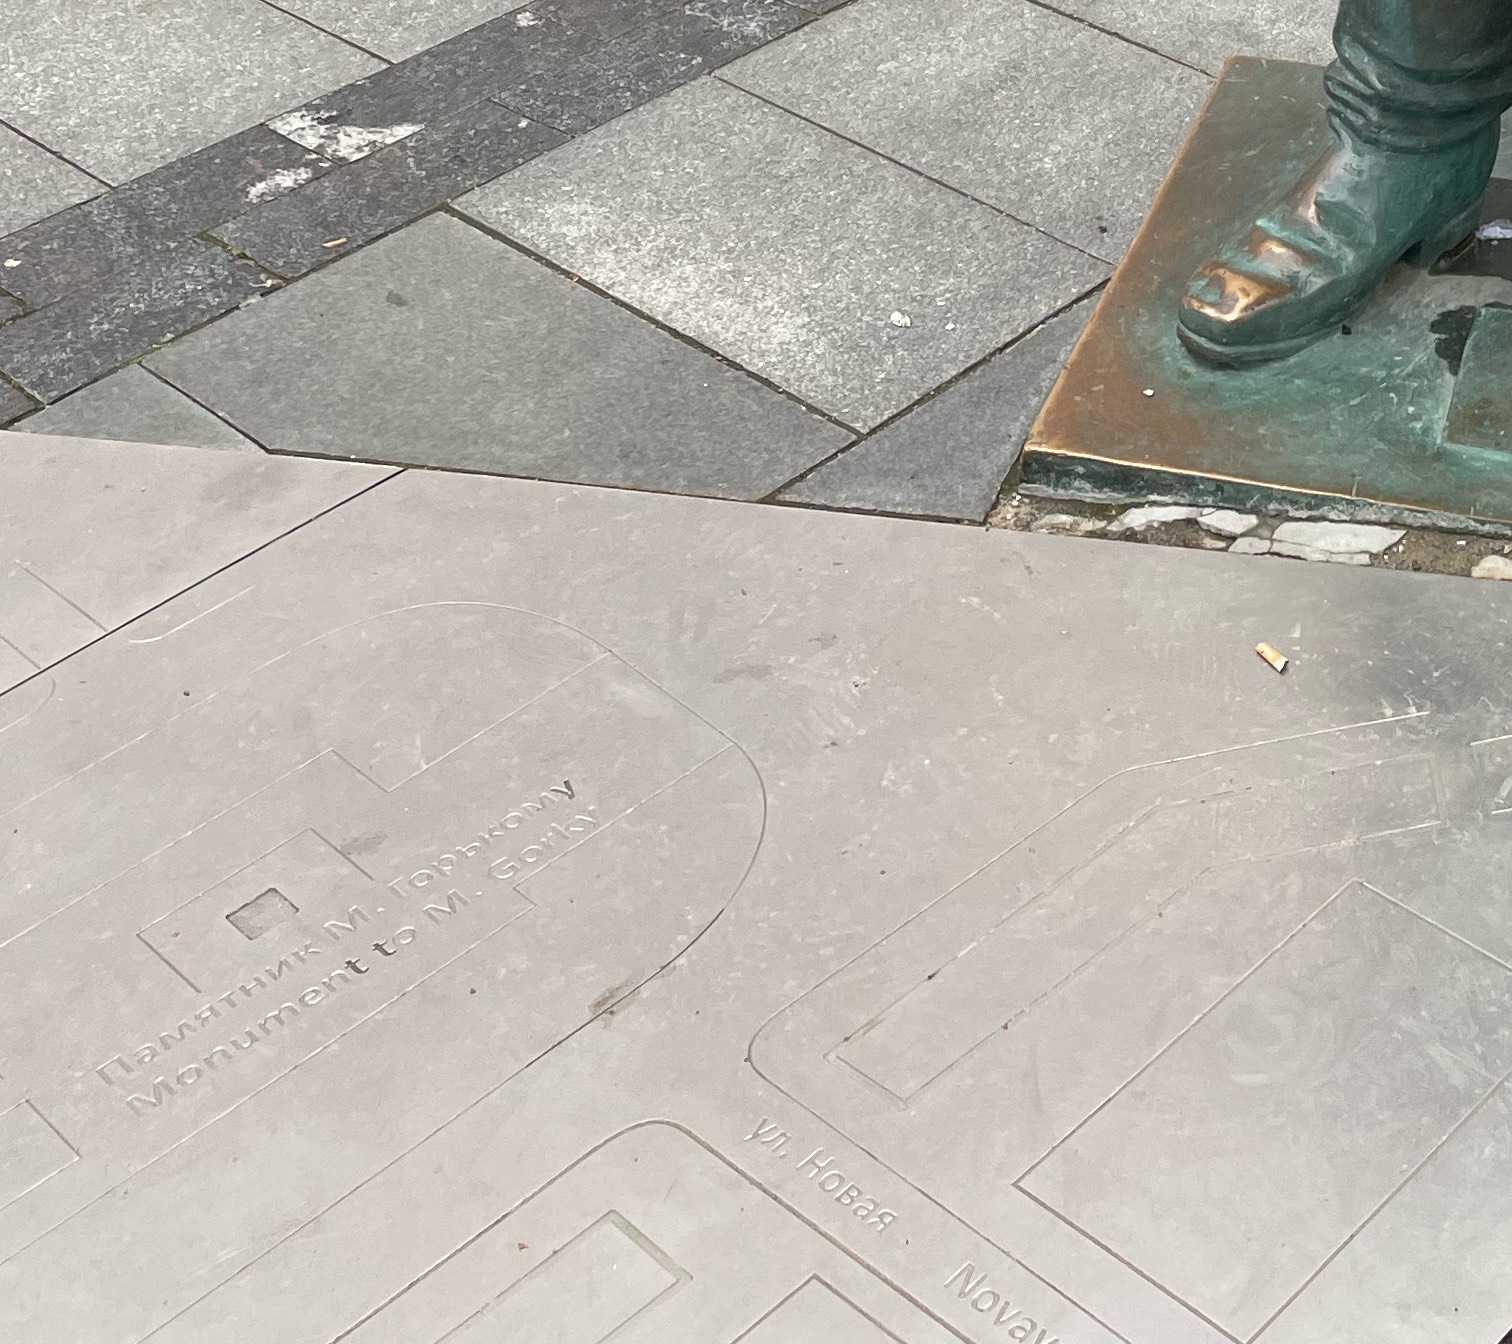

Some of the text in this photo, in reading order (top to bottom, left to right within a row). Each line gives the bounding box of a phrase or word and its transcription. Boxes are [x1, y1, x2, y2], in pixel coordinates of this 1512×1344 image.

[96, 779, 576, 1086] Памятник М. Горькому
[126, 806, 598, 1117] Monument to M. Gorky
[795, 1146, 899, 1233] Новая
